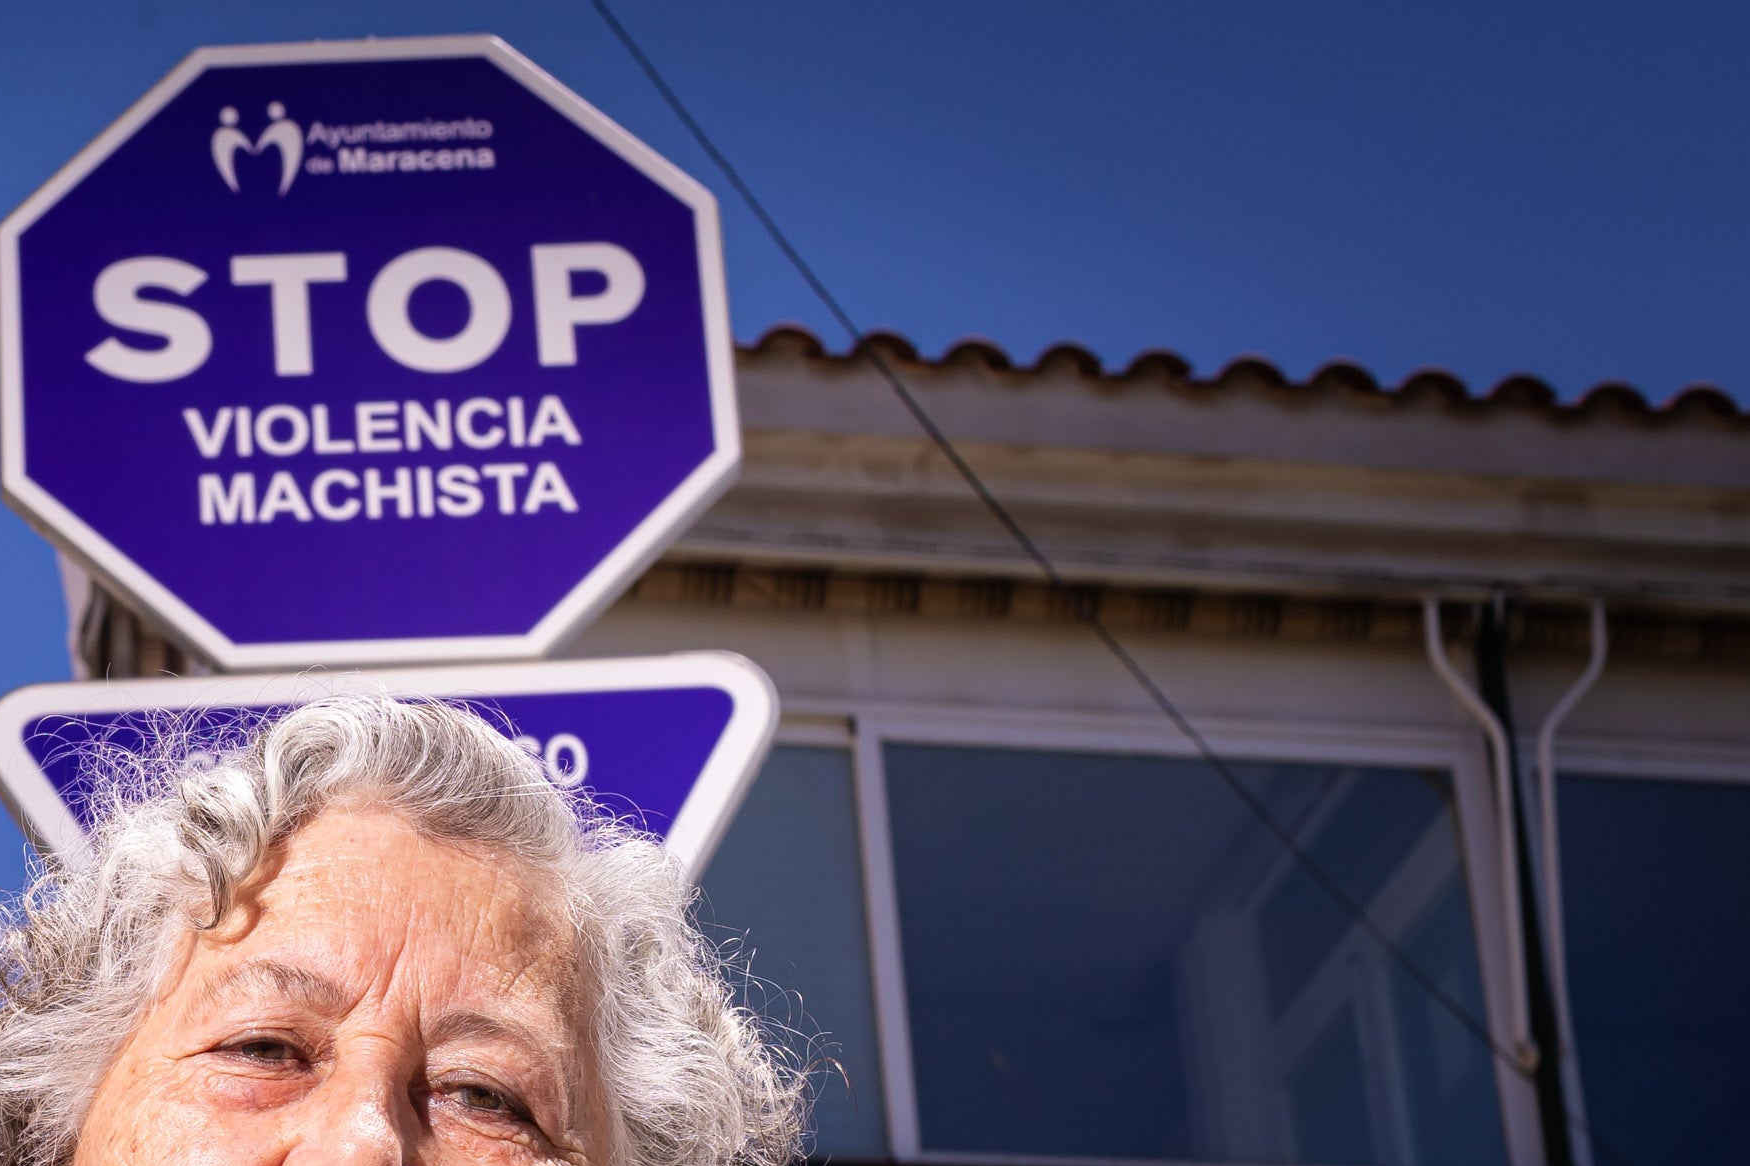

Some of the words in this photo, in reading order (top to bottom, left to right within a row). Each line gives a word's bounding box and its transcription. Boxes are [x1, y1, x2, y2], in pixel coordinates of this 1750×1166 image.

[305, 154, 335, 174] de
[336, 147, 496, 173] Maracena
[307, 117, 493, 149] Ayuntamiento
[85, 242, 646, 383] STOP
[183, 395, 582, 459] VIOLENCIA
[198, 461, 578, 525] MACHISTA
